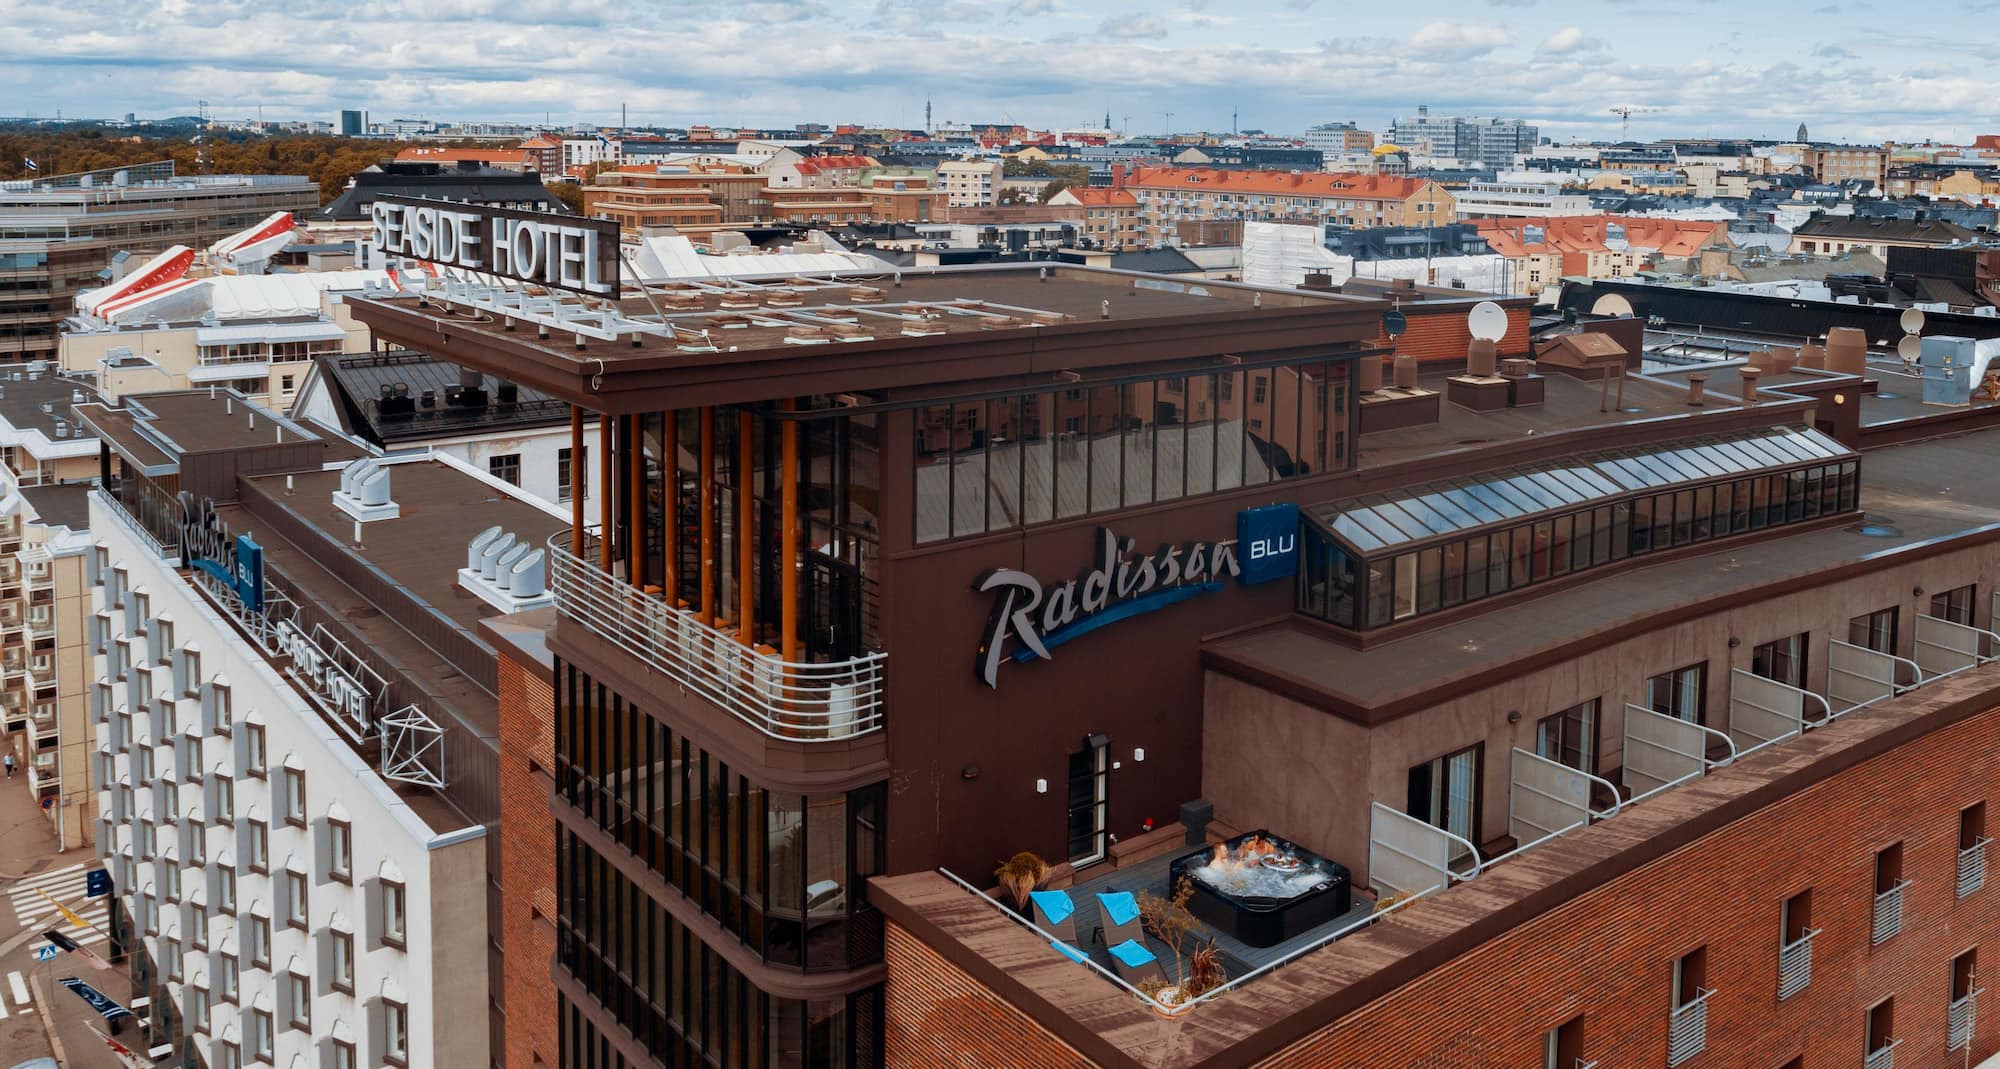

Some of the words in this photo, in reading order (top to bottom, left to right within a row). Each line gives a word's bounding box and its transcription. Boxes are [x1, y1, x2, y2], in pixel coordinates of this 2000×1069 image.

[372, 201, 482, 268] SEASIDE
[492, 217, 612, 293] HOTEL
[238, 562, 254, 587] BLU
[977, 527, 1240, 690] Radisson
[1250, 533, 1294, 560] BLU
[277, 621, 324, 686] SEASIDE
[326, 666, 369, 729] HOTEL
